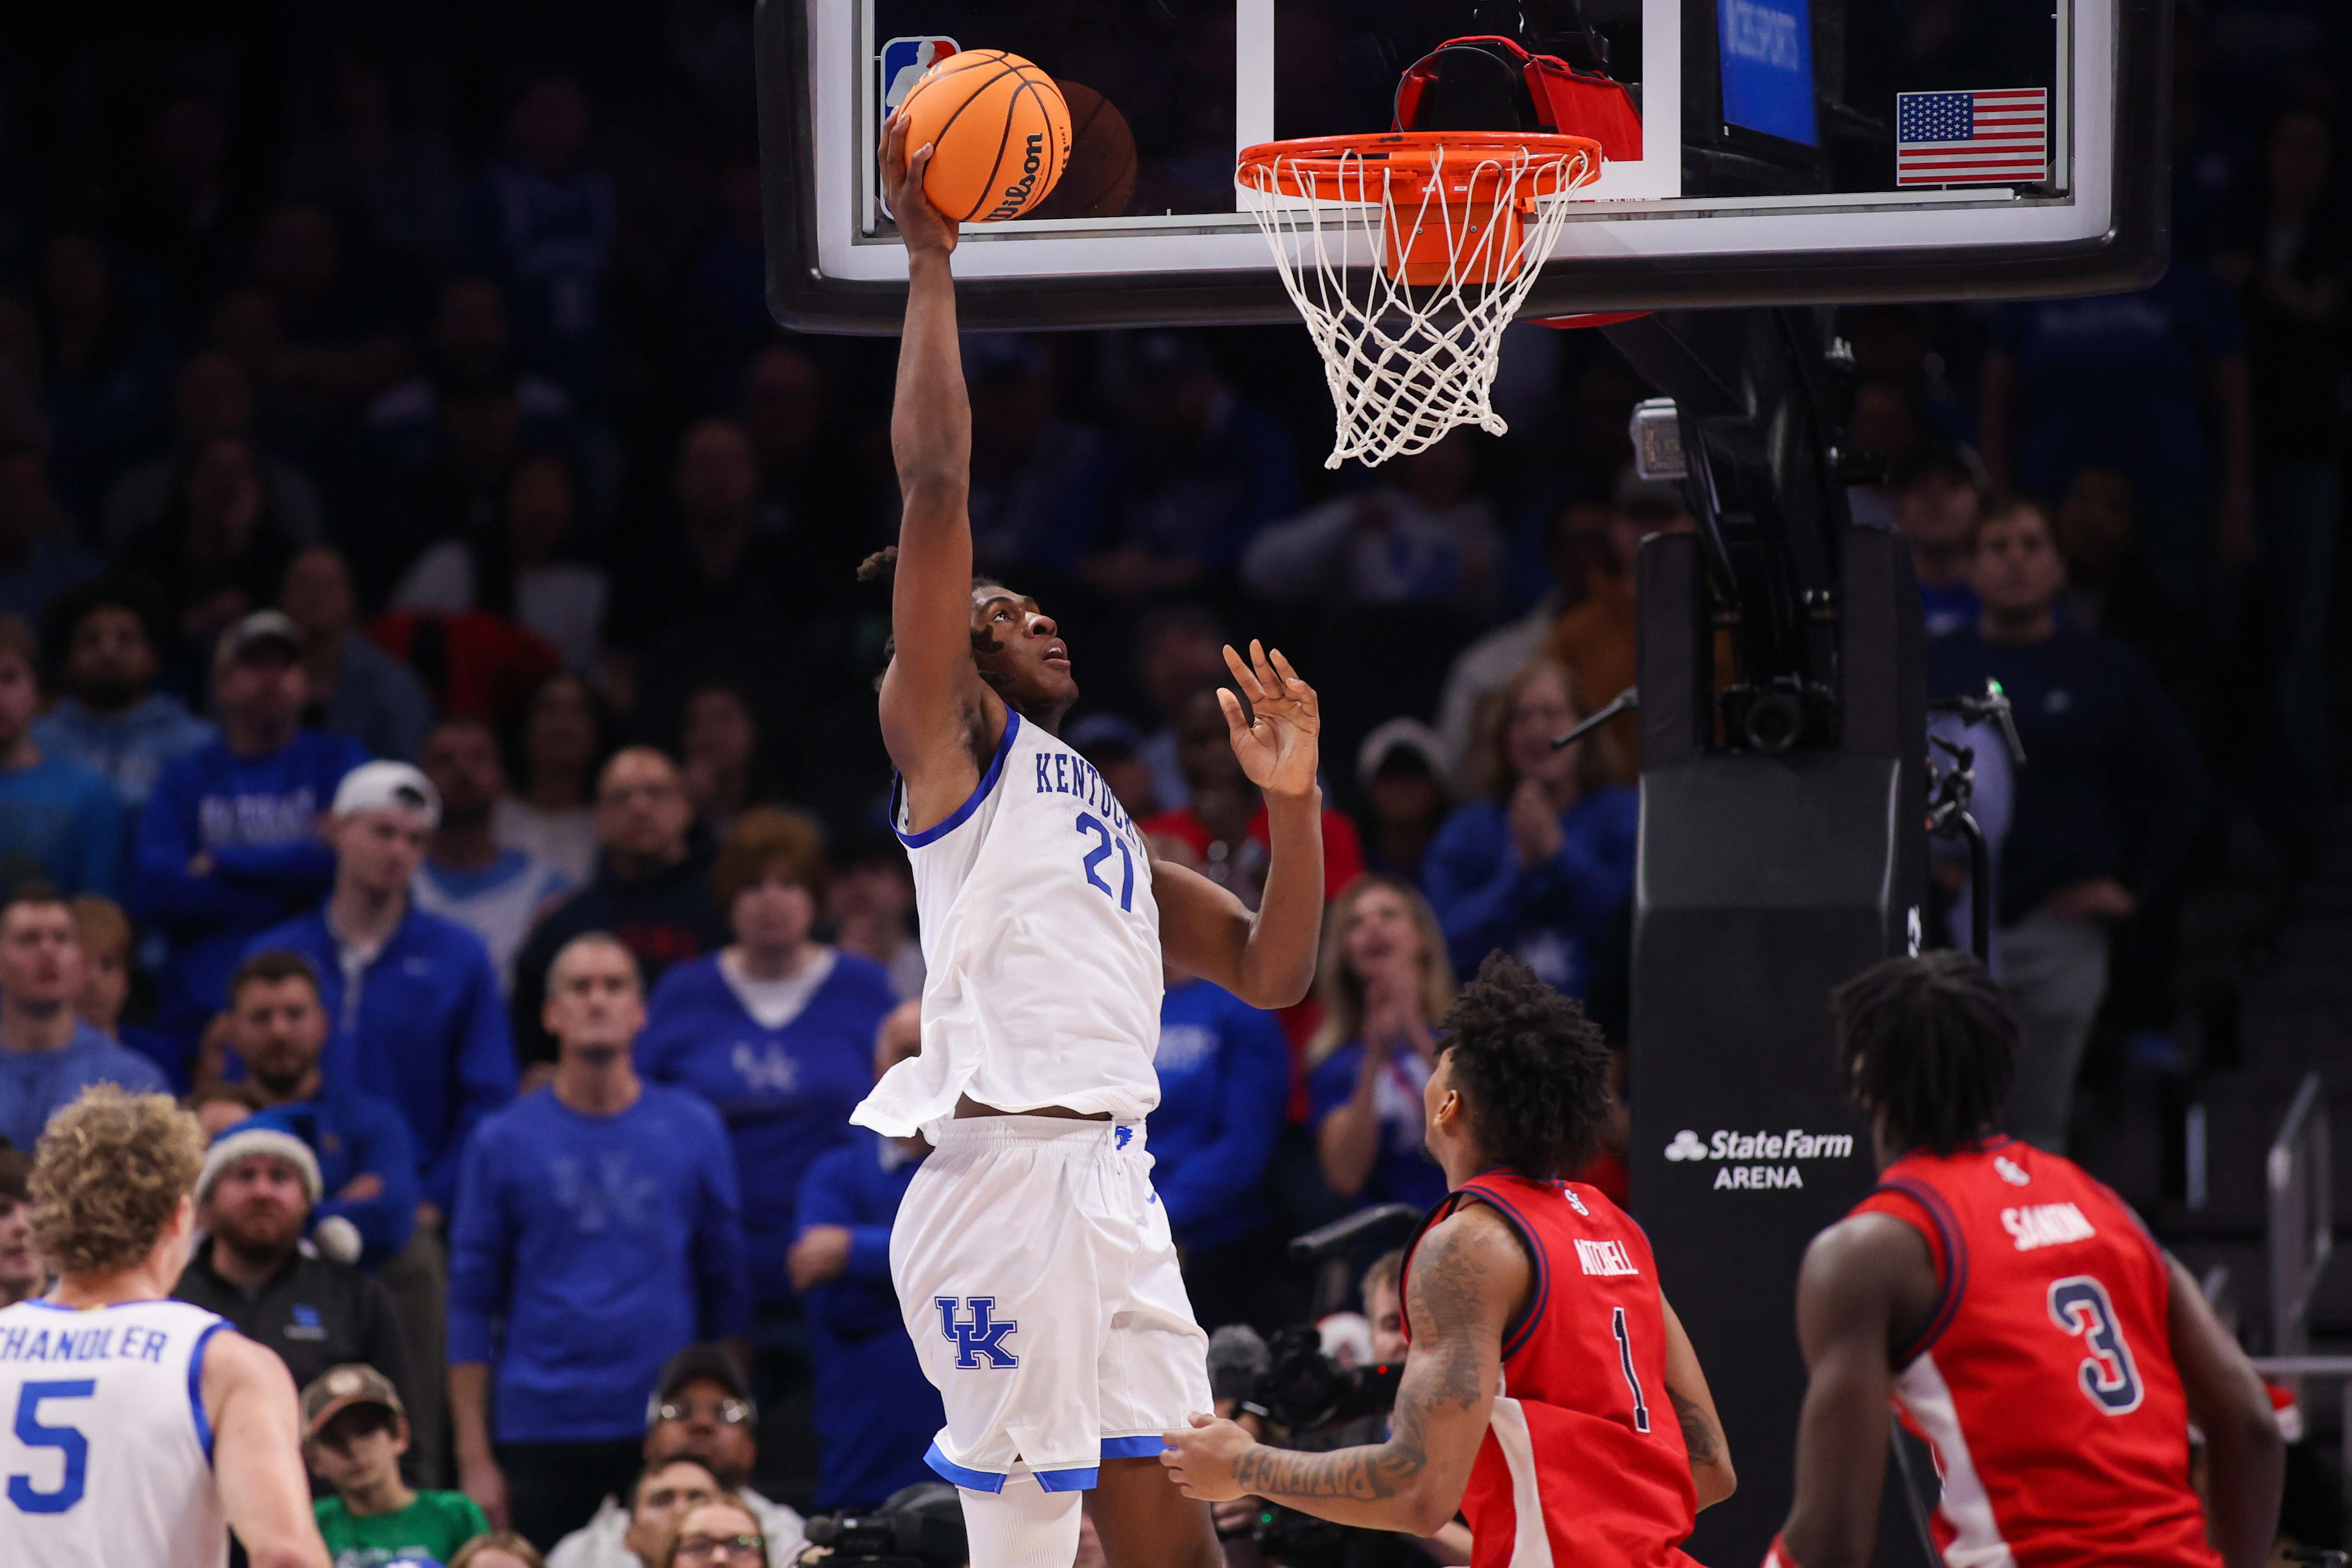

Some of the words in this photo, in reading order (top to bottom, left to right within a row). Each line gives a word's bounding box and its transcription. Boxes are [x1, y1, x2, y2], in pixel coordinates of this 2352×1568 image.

[981, 131, 1043, 221] Wilson
[1036, 753, 1142, 858] KENTUCK
[1076, 811, 1134, 913] 21
[1713, 1166, 1804, 1190] ARENA
[0, 1326, 168, 1363] HANDLER
[934, 1296, 1019, 1369] UK
[1612, 1306, 1651, 1433] 1
[2047, 1274, 2145, 1416] 3
[6, 1378, 97, 1514] 5
